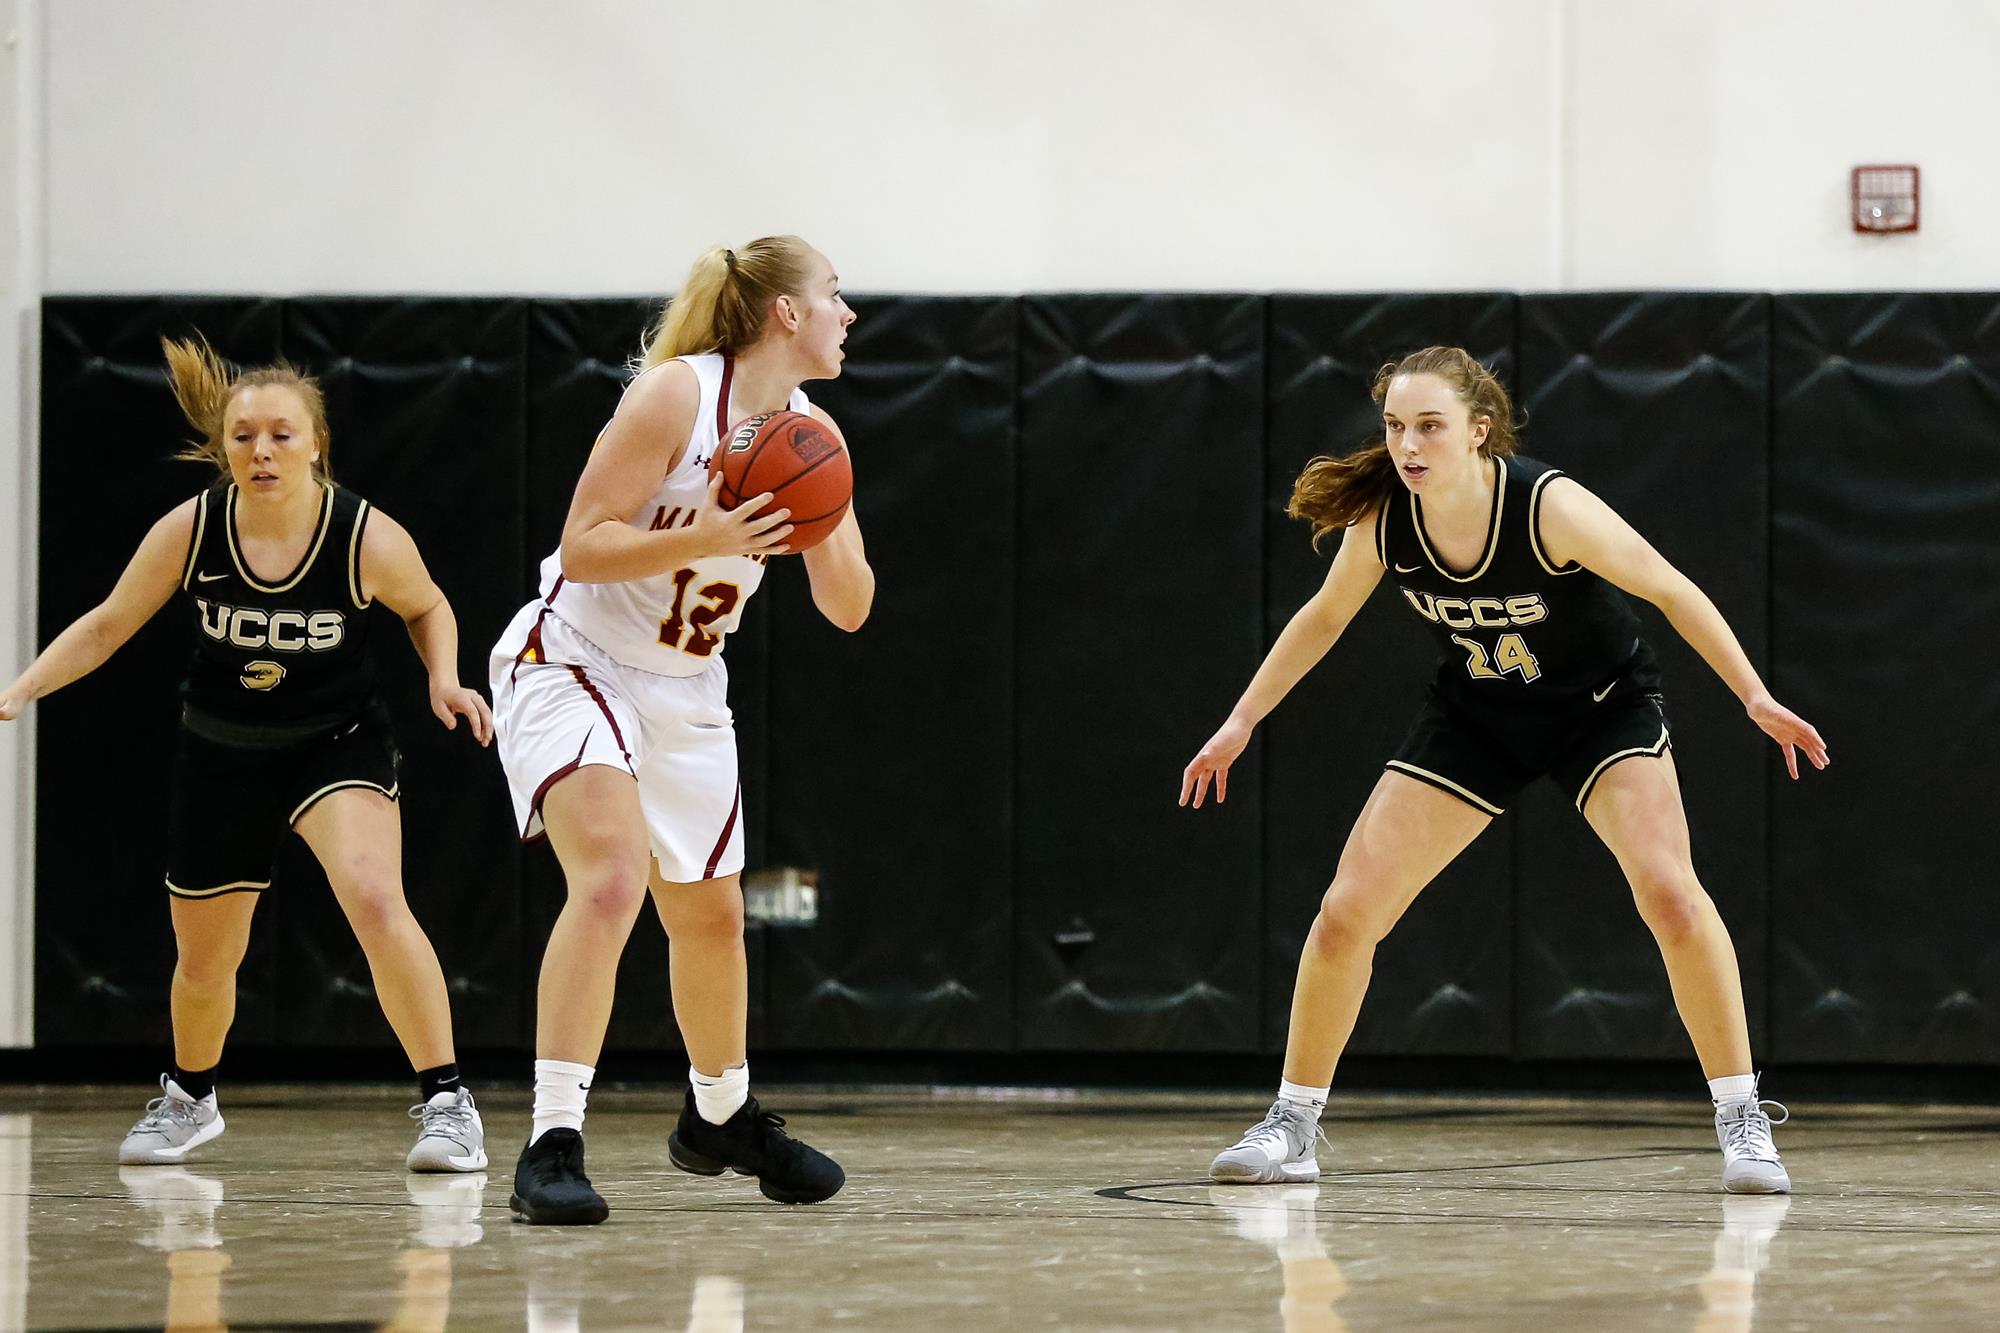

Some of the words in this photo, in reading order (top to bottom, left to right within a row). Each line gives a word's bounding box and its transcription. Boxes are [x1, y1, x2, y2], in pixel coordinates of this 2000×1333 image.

[195, 597, 346, 652] UCCS
[657, 569, 740, 657] 12
[1401, 587, 1549, 630] UCCS
[240, 660, 287, 691] 3
[1451, 633, 1541, 684] 24
